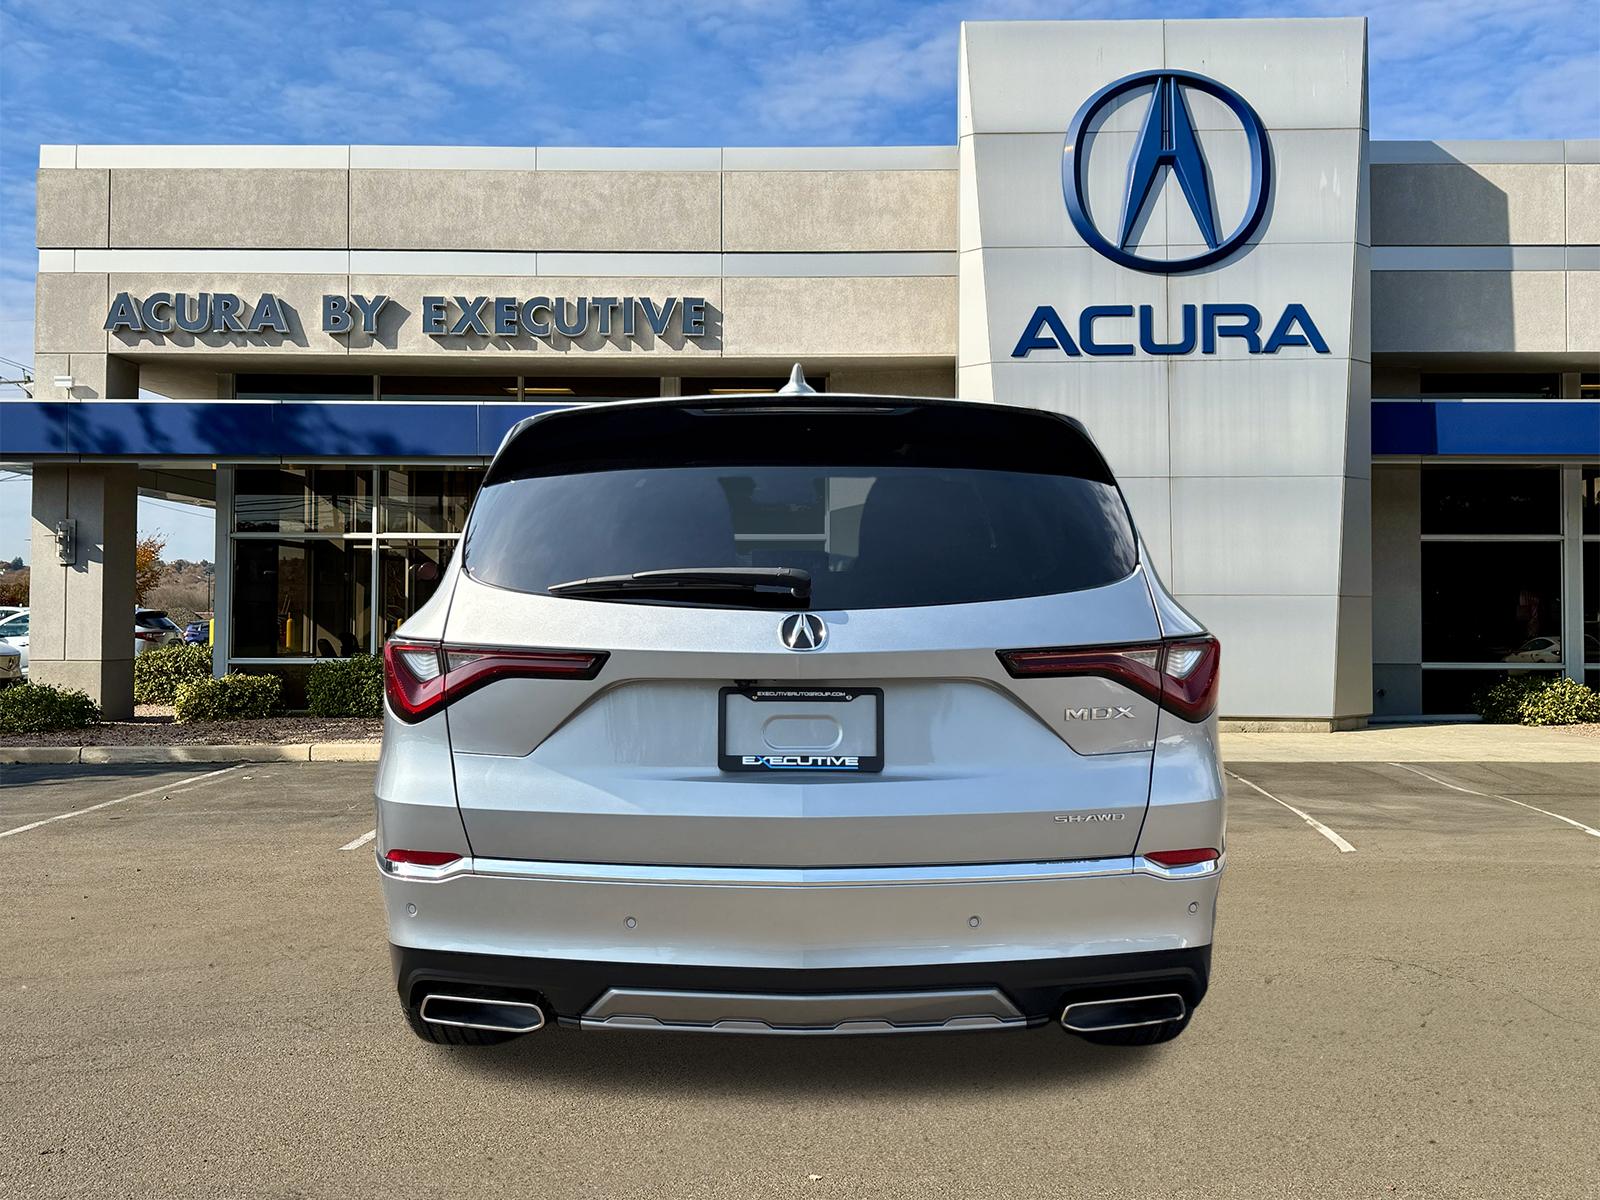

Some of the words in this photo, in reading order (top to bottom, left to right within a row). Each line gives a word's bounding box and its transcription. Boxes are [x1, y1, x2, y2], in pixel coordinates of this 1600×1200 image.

[104, 291, 291, 333] ACURA
[322, 294, 390, 335] BY
[422, 296, 706, 337] EXECUTIVE
[1011, 303, 1331, 357] ACURA
[1064, 706, 1136, 722] MDX
[741, 756, 859, 767] EXECUTIVE
[1053, 813, 1126, 824] SH-AWD
